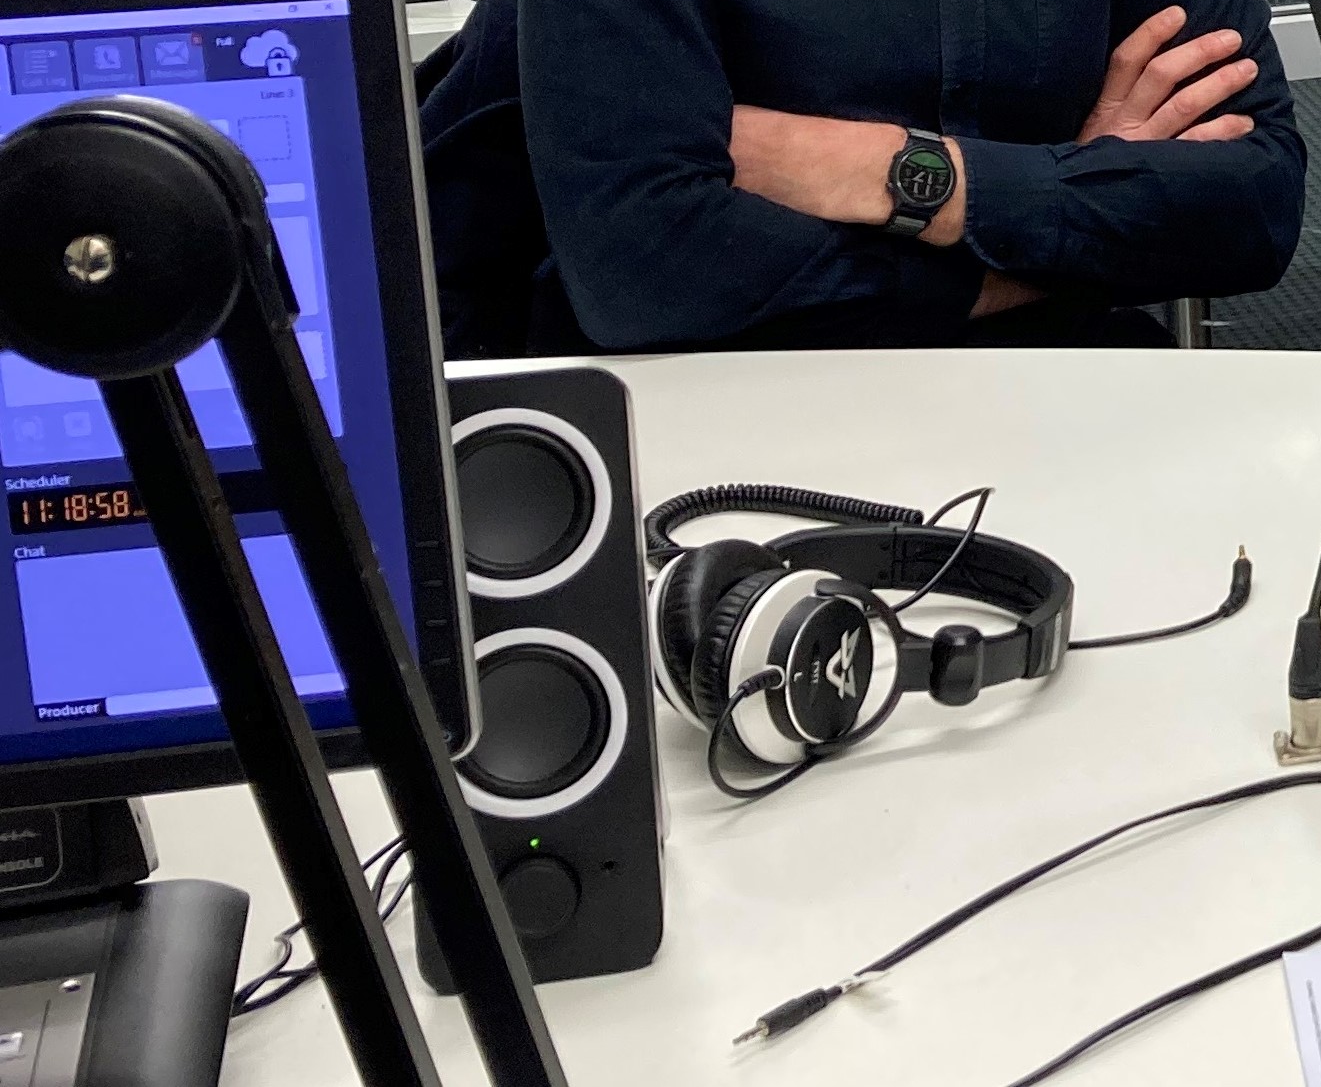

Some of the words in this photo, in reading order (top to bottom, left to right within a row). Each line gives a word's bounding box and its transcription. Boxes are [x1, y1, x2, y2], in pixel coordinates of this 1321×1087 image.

[4, 474, 72, 490] Scheduler
[13, 546, 46, 558] Chat
[38, 703, 100, 719] Producer
